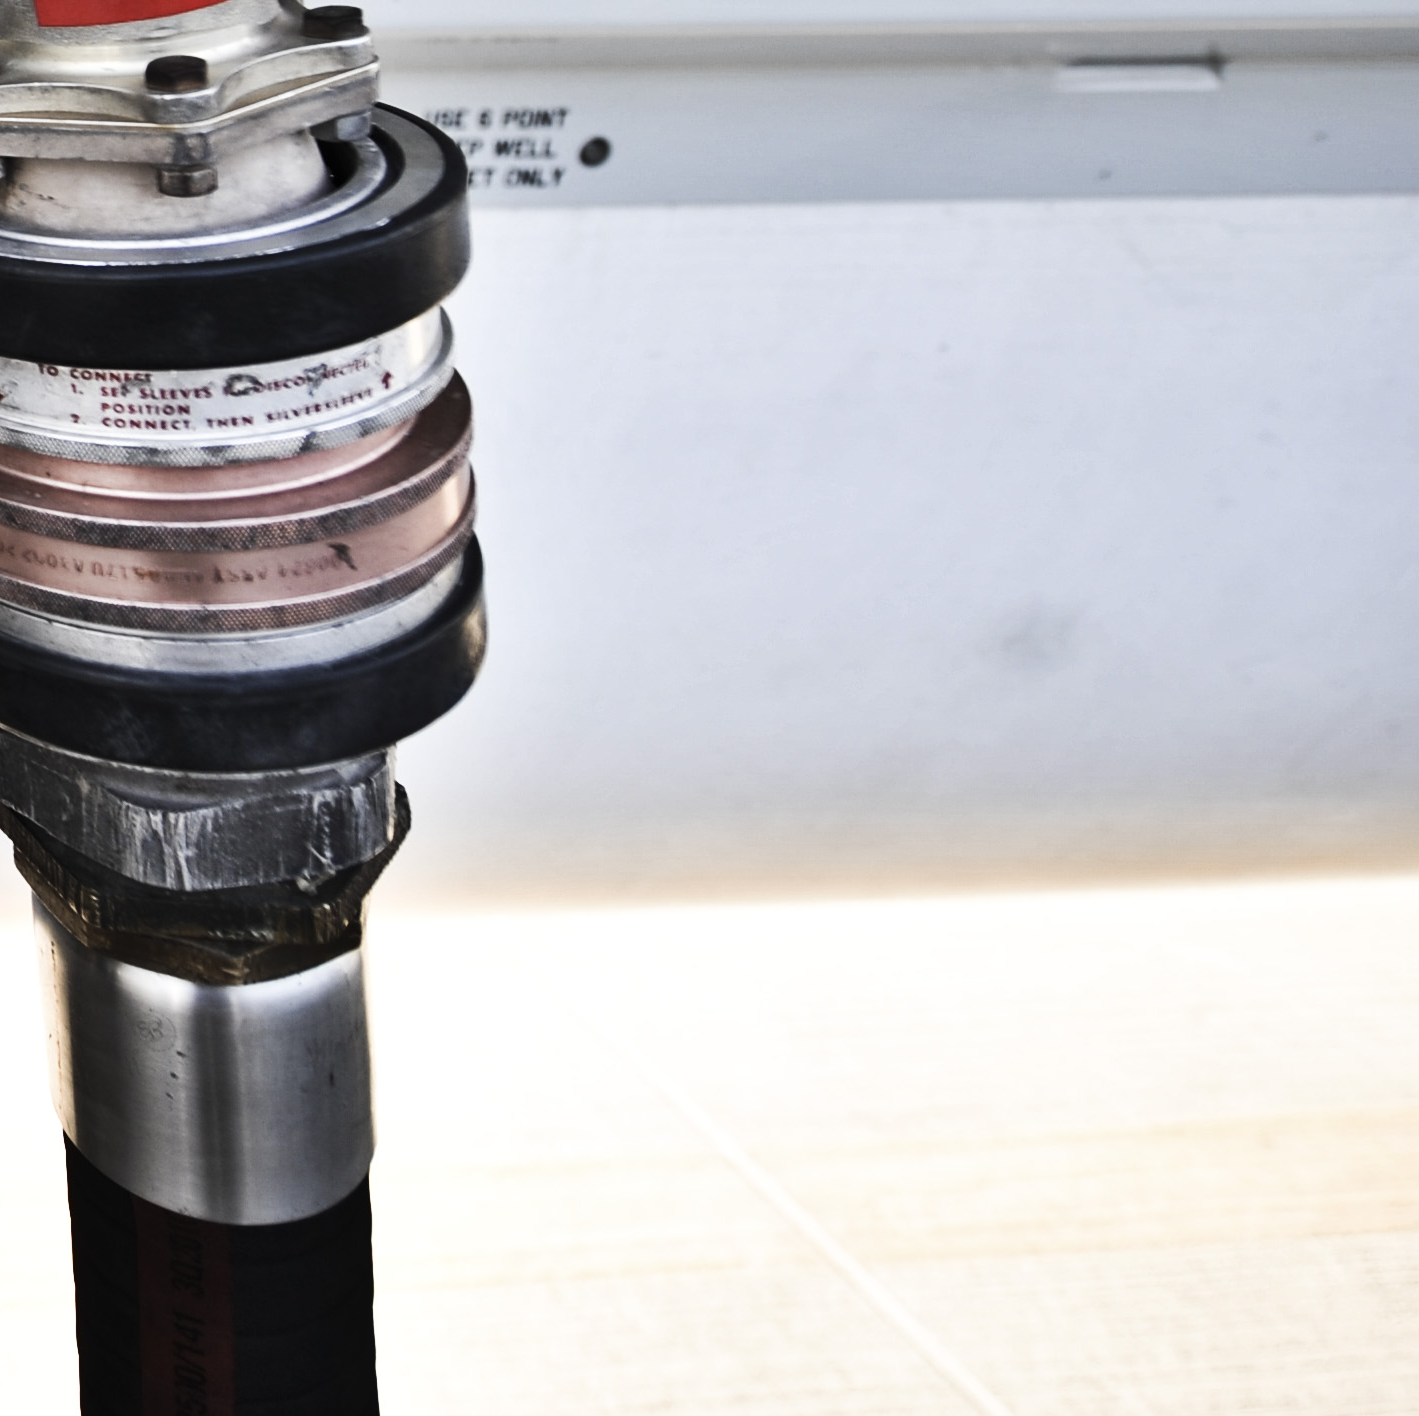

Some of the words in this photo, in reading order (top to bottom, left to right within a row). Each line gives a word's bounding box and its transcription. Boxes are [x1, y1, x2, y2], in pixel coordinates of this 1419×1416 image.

[501, 107, 569, 127] POINT
[495, 139, 557, 157] WELL
[506, 168, 565, 187] ONLY
[37, 363, 59, 377] TO
[70, 369, 152, 383] CONNECT
[140, 386, 212, 400] SLEEVES
[101, 403, 191, 415] POSITION
[207, 416, 254, 428] THEN
